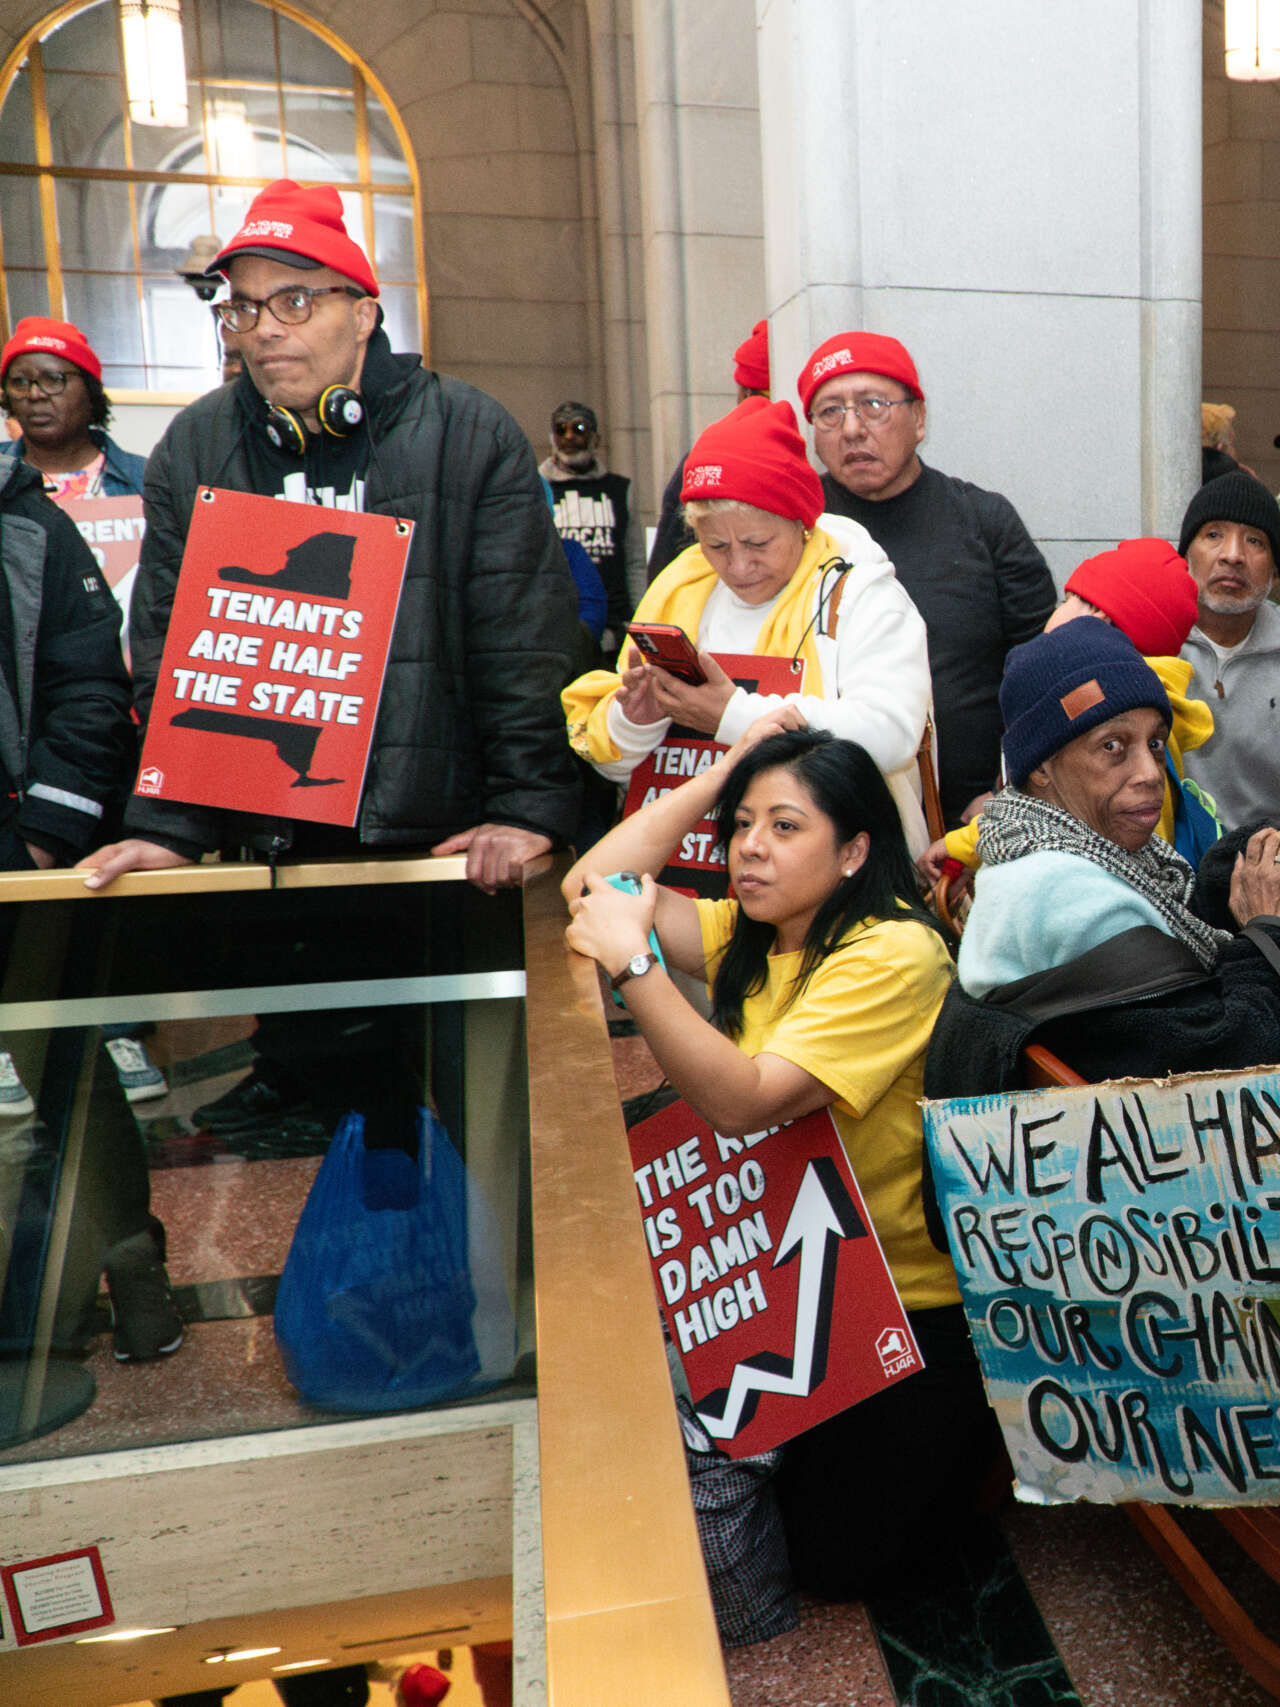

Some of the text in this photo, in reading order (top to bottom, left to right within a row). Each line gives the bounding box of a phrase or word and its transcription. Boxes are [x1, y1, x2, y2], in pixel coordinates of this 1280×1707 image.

[75, 517, 147, 544] RENT
[207, 587, 363, 639] TENANTS
[188, 630, 362, 681] ARE HALF
[172, 668, 364, 725] THE STATE
[633, 1136, 708, 1208] THE
[949, 1105, 1073, 1197] WE
[1086, 1091, 1189, 1202] ALL
[643, 1159, 765, 1259] IS TOO
[658, 1210, 773, 1305] DAMN
[673, 1268, 768, 1353] HIGH
[988, 1297, 1122, 1371] OUR
[883, 1355, 916, 1379] HJ4A
[1026, 1377, 1195, 1497] OUR
